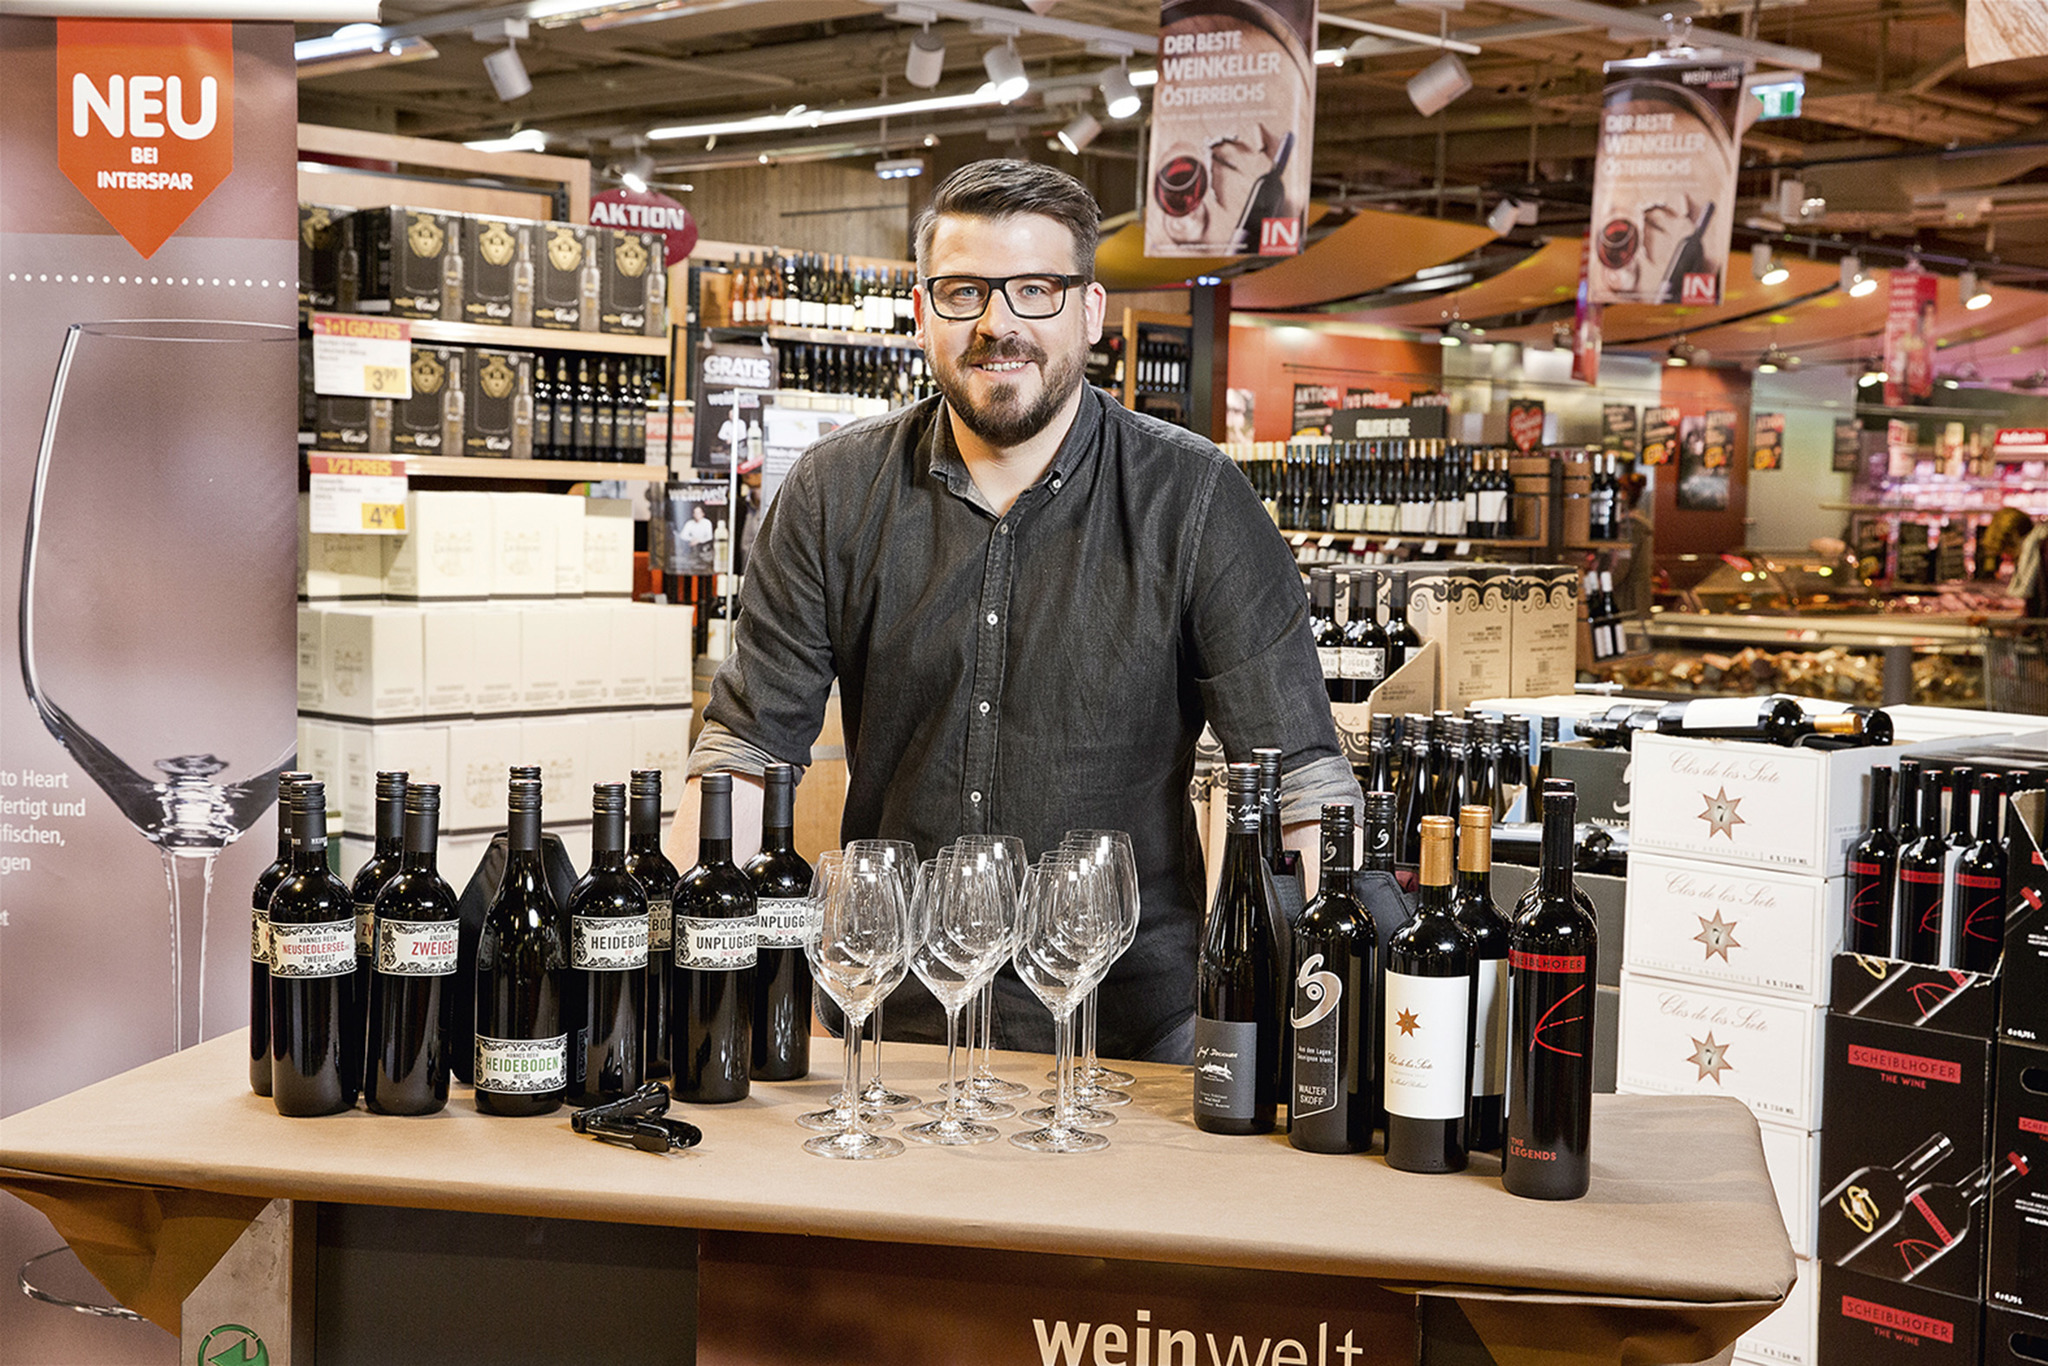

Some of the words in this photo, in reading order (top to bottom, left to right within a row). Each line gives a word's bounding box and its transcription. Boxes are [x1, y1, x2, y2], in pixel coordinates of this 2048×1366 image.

[1164, 34, 1195, 54] DER
[1196, 30, 1242, 51] BESTE
[1162, 52, 1281, 81] WEINKELLER
[1160, 83, 1266, 106] ÖSTERREICHS
[73, 73, 217, 140] NEU
[1605, 133, 1706, 154] WEINKELLER
[131, 147, 158, 164] BEI
[97, 171, 193, 190] INTERSPAR
[590, 201, 685, 231] AKTION
[1262, 220, 1298, 246] IN
[1683, 275, 1715, 297] IN
[347, 321, 401, 339] GRATIS
[703, 355, 771, 379] GRATIS
[352, 459, 392, 476] PREIS
[1669, 750, 1699, 774] Clos
[1703, 761, 1720, 776] de
[1722, 761, 1739, 779] los
[1743, 759, 1780, 782] Siete
[0, 772, 17, 786] to
[23, 770, 69, 788] Heart
[53, 798, 86, 816] und
[1716, 805, 1726, 822] 7
[1712, 928, 1722, 945] 7
[282, 941, 345, 955] NEUSIEDLERSEE
[303, 954, 336, 964] ZWEIGELT
[485, 1057, 559, 1073] HEIDEBODEN
[1705, 1049, 1716, 1065] 7
[1853, 1050, 1956, 1079] SCHEIBLHOFER
[1298, 1084, 1327, 1096] WALTER
[1881, 1073, 1898, 1084] THE
[1902, 1078, 1927, 1089] WINE
[1300, 1094, 1323, 1105] SKOFF
[1511, 1137, 1524, 1146] THE
[1511, 1146, 1557, 1161] LEGENDS
[1846, 1302, 1949, 1338] SCHEIBLHOFER
[1874, 1327, 1891, 1339] THE
[1894, 1331, 1919, 1346] WINE
